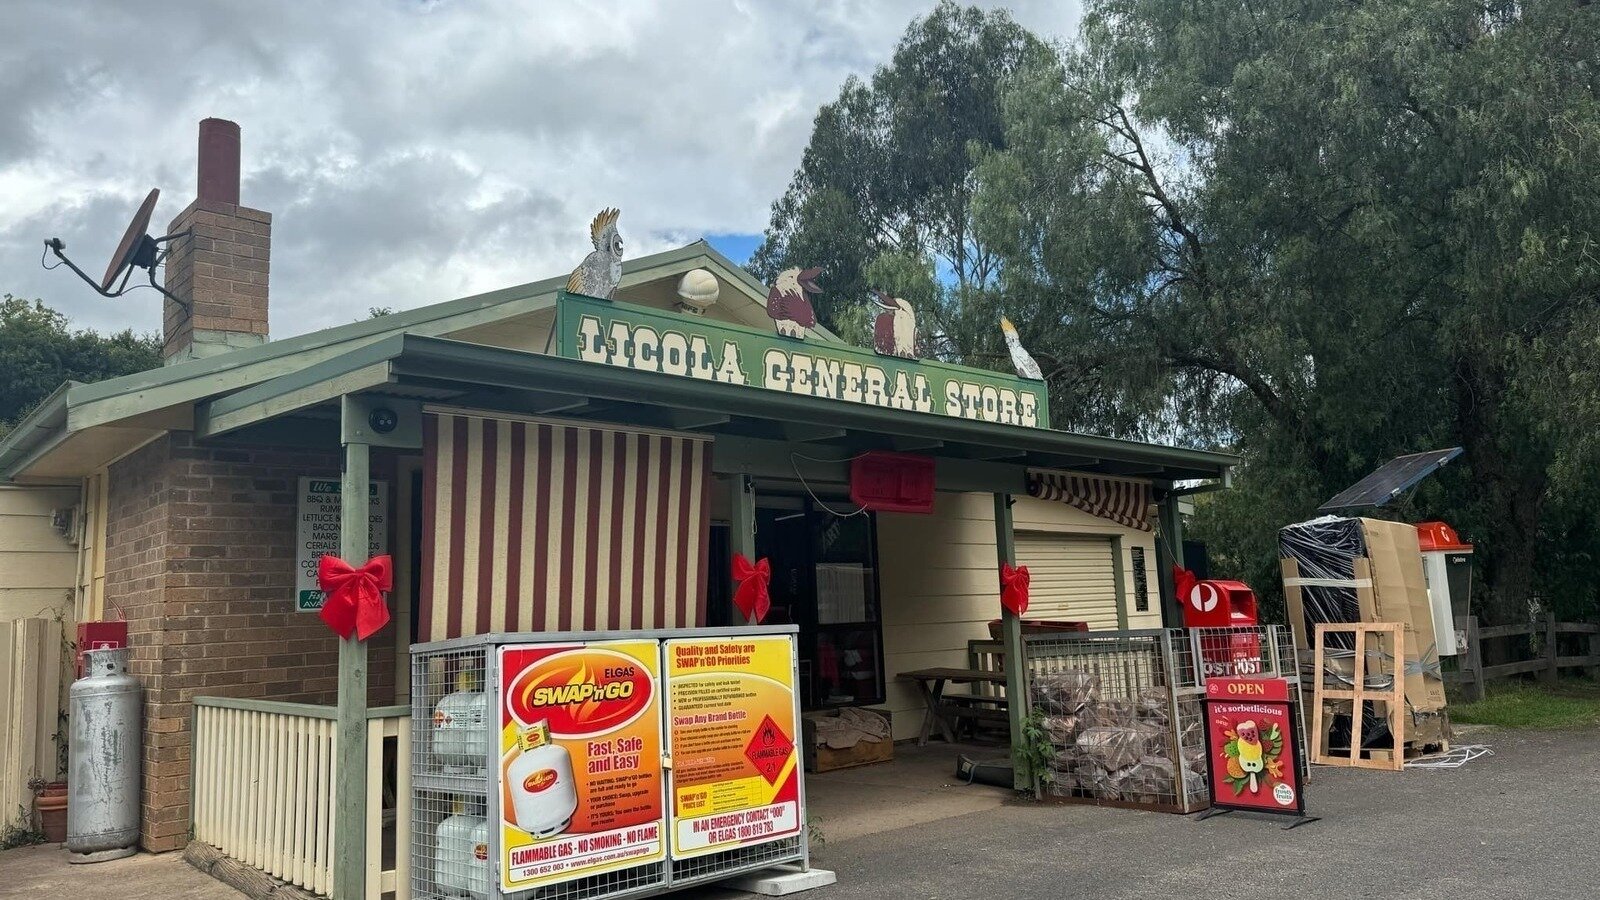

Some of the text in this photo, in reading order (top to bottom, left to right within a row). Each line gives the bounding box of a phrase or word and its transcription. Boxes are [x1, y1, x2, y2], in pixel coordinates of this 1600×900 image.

[578, 315, 1039, 427] LICOLA GENERAL STORE
[306, 495, 324, 503] BBQ
[302, 514, 333, 522] LETTUCE
[312, 523, 342, 531] BACON
[312, 533, 338, 541] MARG
[305, 541, 337, 549] CERIALS
[675, 644, 755, 657] Quality and Safety are
[717, 655, 751, 666] Priorities
[605, 667, 634, 678] ELGAS
[1227, 683, 1265, 695] OPEN
[1214, 704, 1282, 716] it's sorbetlicious
[674, 710, 746, 726] Swap Any Brand Bottle
[587, 737, 643, 757] Fast, Safe
[752, 748, 778, 759] FLAMMABLE
[779, 747, 788, 756] GAS
[588, 754, 639, 773] and Easy
[682, 800, 706, 810] PRICE LIST
[693, 821, 700, 833] IN
[701, 819, 709, 831] AN
[711, 813, 745, 829] EMERGENCY
[746, 808, 769, 823] CONTACT
[708, 820, 774, 844] OR ELGAS 1800 819 783
[511, 846, 557, 866] FLAMMABLE
[558, 843, 573, 857] GAS
[578, 839, 589, 853] NO
[590, 832, 622, 850] SMOKING
[627, 831, 636, 844] NO
[637, 826, 658, 842] FLAME
[523, 846, 650, 877] 1300 652 003 www.elgas.com.au/swapngo
